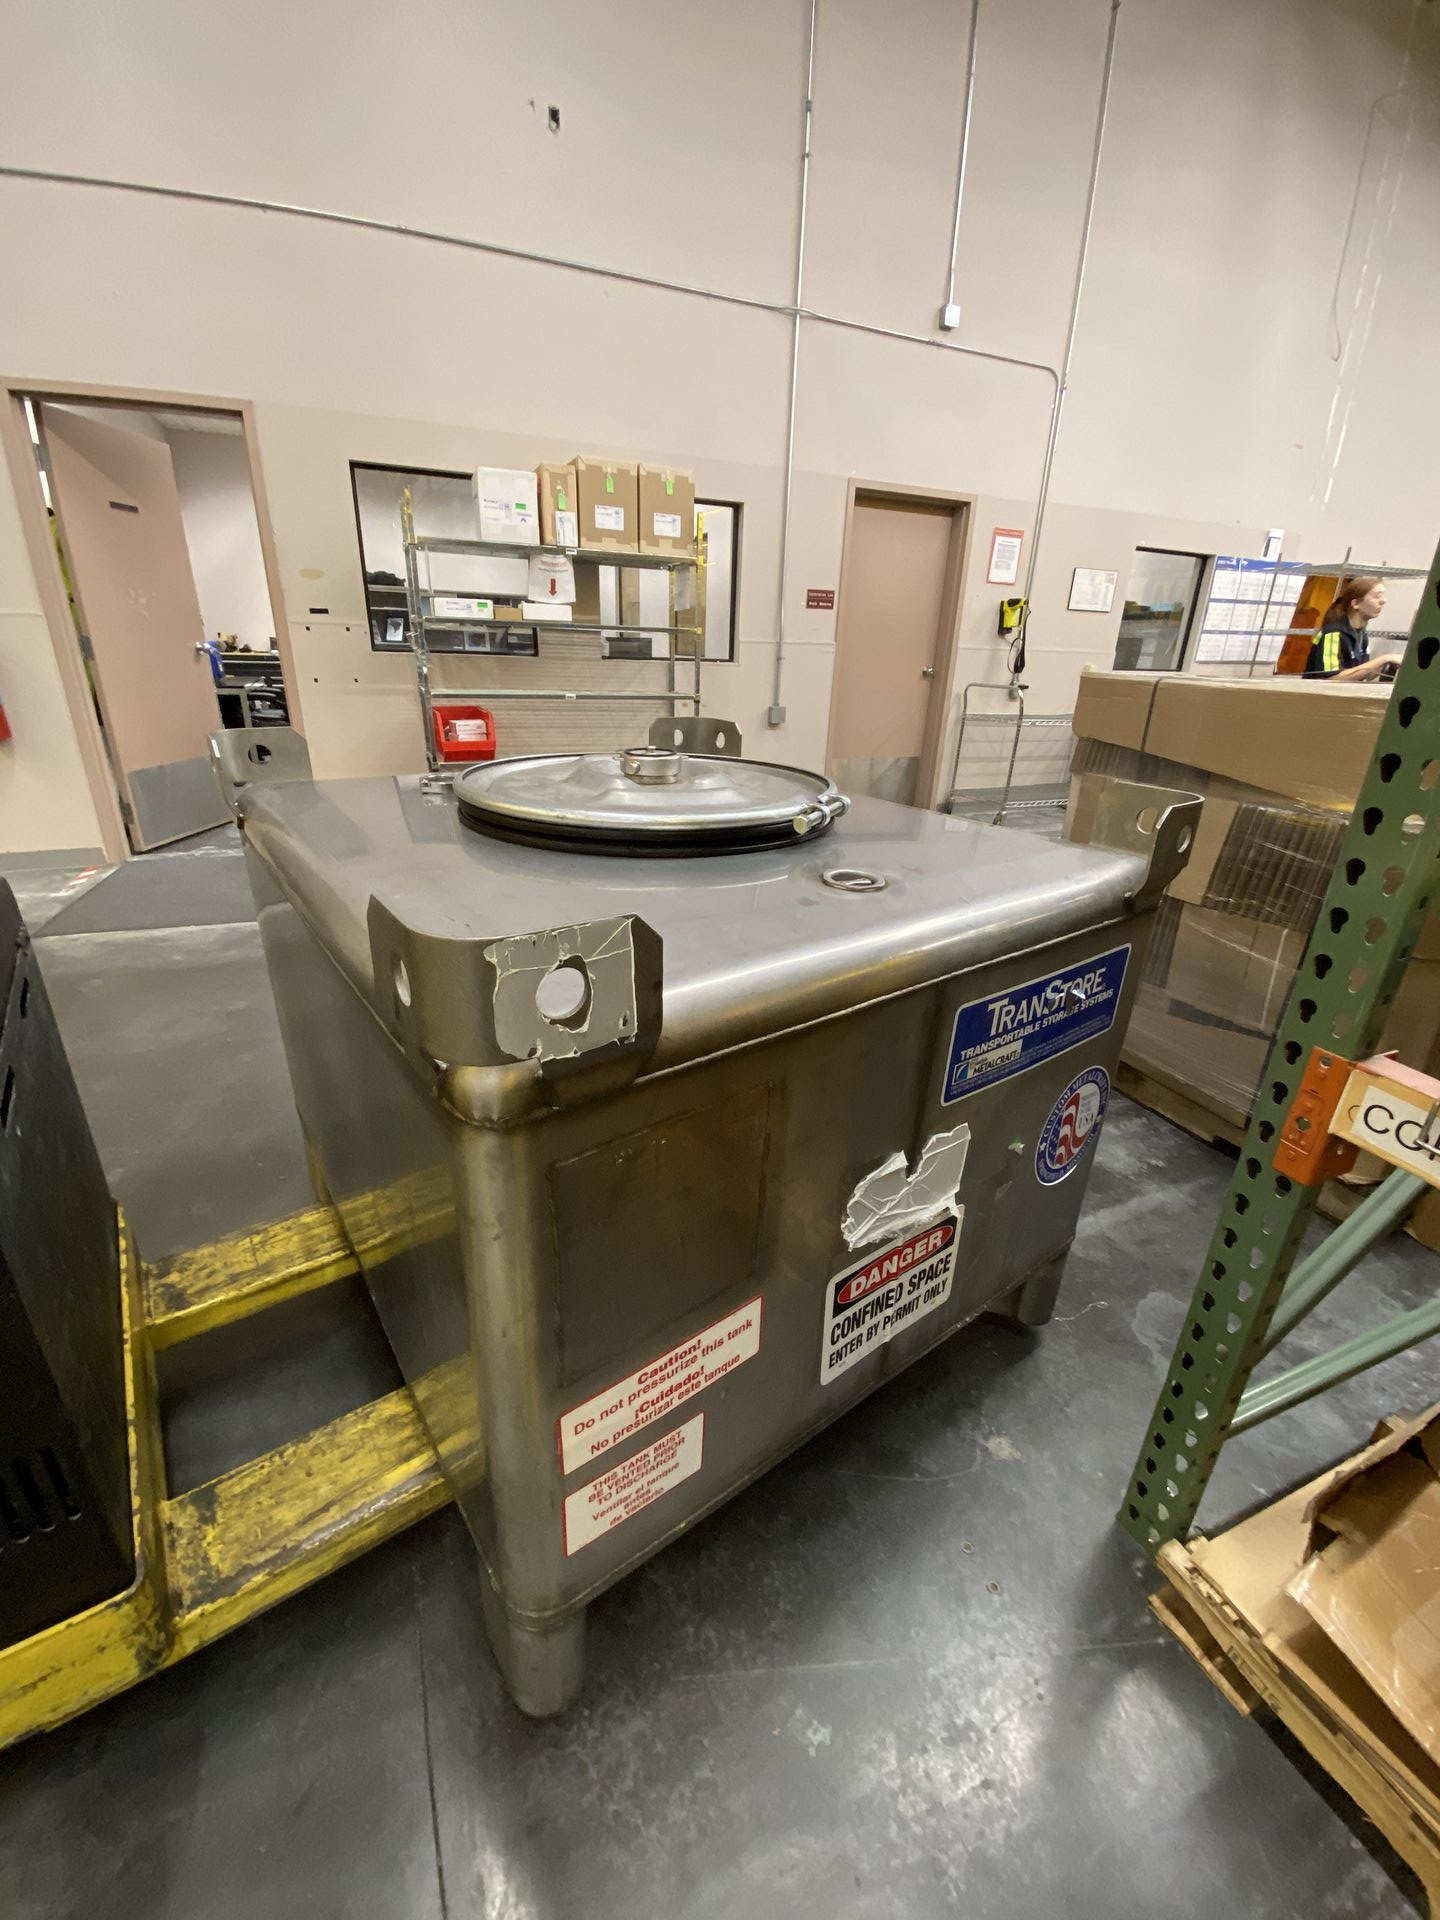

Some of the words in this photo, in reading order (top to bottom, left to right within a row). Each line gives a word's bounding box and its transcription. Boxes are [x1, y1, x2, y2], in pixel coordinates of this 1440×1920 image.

[960, 1021, 1041, 1061] TRANSPORTABLE
[1041, 1003, 1080, 1028] STORAE
[1081, 988, 1114, 1011] SYSTEMS
[830, 1282, 904, 1346] CONFINED
[907, 1252, 953, 1297] SPACE
[849, 1229, 944, 1300] DANGER
[828, 1332, 863, 1369] ENTER
[866, 1319, 881, 1342] BY
[883, 1295, 921, 1331] PERMIT
[923, 1276, 948, 1304] ONLY
[573, 1417, 596, 1437] Do
[599, 1400, 624, 1422] not
[627, 1353, 698, 1407] pressurize
[701, 1337, 724, 1358] this
[727, 1318, 753, 1342] tank
[637, 1339, 702, 1386] Caution!
[590, 1438, 609, 1455] No
[612, 1397, 675, 1444] presurizar
[677, 1380, 701, 1401] este
[703, 1353, 741, 1384] tanque
[588, 1488, 604, 1504] BE
[607, 1459, 651, 1491] VENTED
[653, 1436, 686, 1463] PRIOR
[592, 1472, 618, 1491] THIS
[621, 1451, 650, 1474] TANK
[653, 1430, 683, 1455] MUST
[597, 1492, 613, 1505] TO
[615, 1449, 678, 1495] DISCHARGE
[635, 1484, 644, 1495] el
[609, 1515, 623, 1527] de
